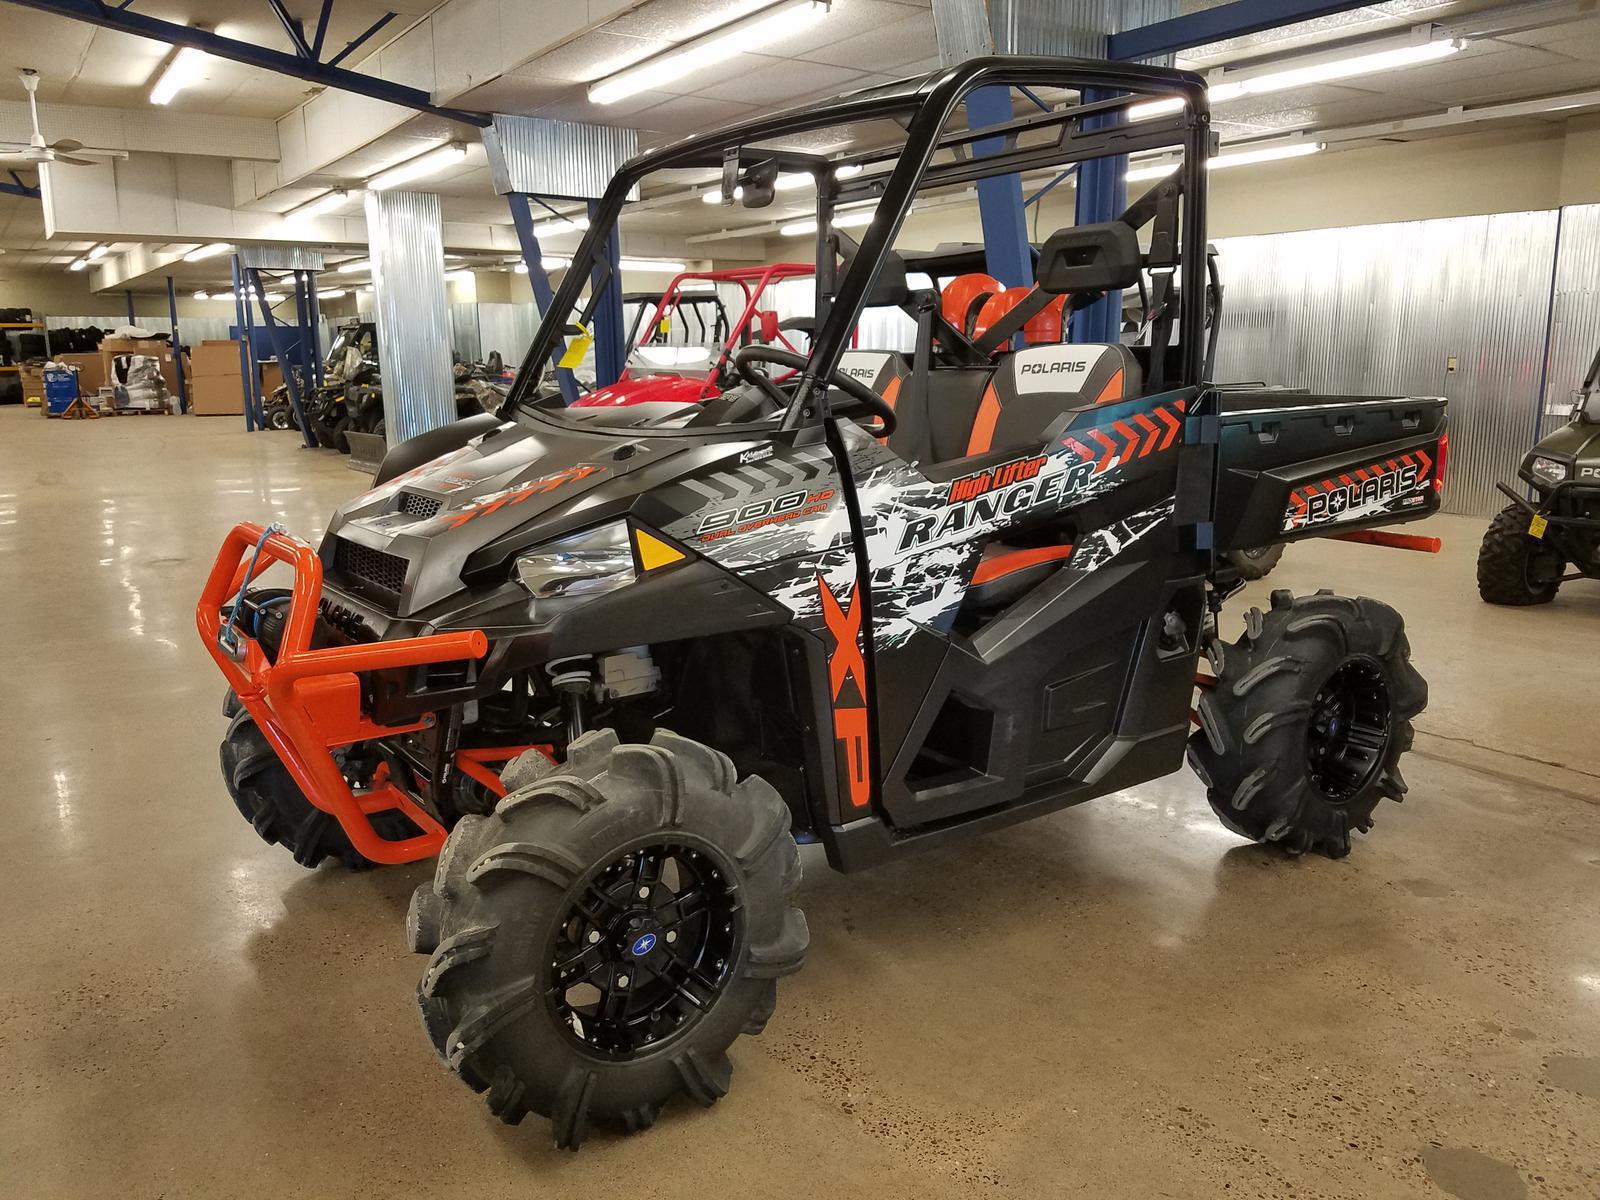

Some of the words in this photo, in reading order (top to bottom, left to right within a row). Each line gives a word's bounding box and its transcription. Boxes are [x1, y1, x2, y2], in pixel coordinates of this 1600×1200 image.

[839, 367, 874, 379] OLARIS
[1020, 361, 1087, 375] POLARIS
[949, 473, 990, 504] High
[992, 455, 1048, 489] Lifter
[1307, 464, 1418, 524] POLARIS
[696, 490, 807, 534] 900
[700, 529, 736, 543] DUAL
[737, 510, 801, 533] OVERHEAD
[802, 503, 828, 516] CAM
[896, 461, 1096, 554] RANGER
[817, 574, 871, 807] XP
